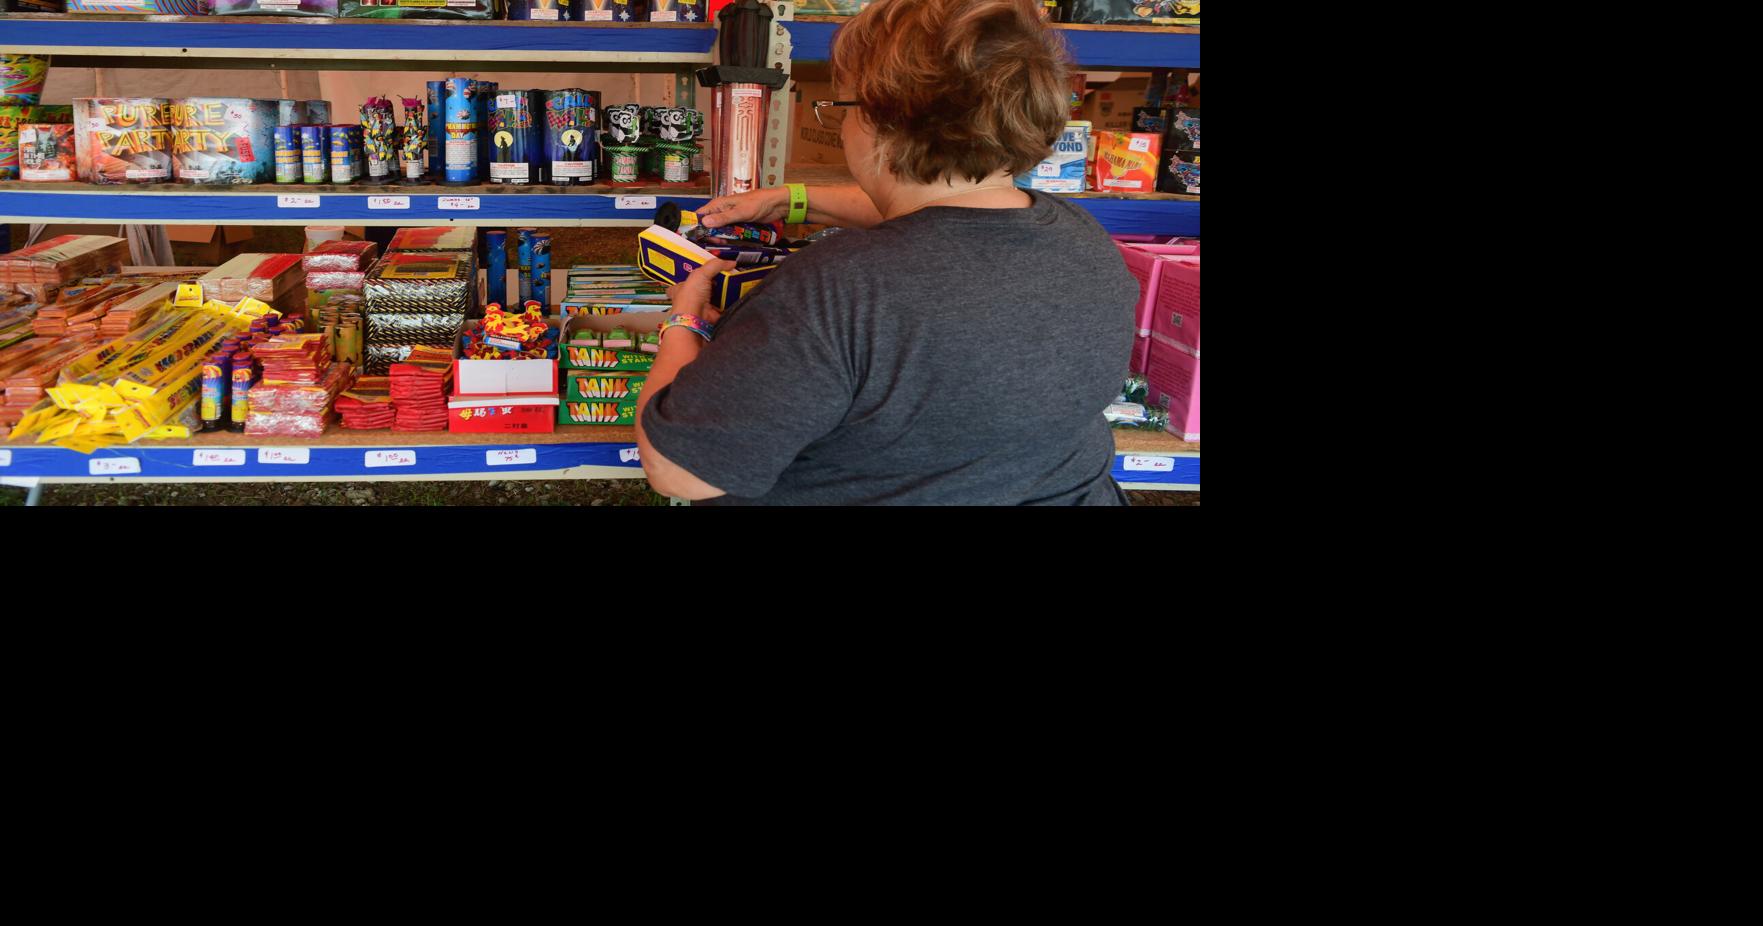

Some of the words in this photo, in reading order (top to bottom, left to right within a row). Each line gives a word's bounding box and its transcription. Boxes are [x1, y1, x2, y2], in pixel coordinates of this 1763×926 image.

[1052, 142, 1083, 152] YOND
[567, 346, 620, 368] TANK
[575, 377, 630, 399] TANK
[566, 402, 621, 423] TANK
